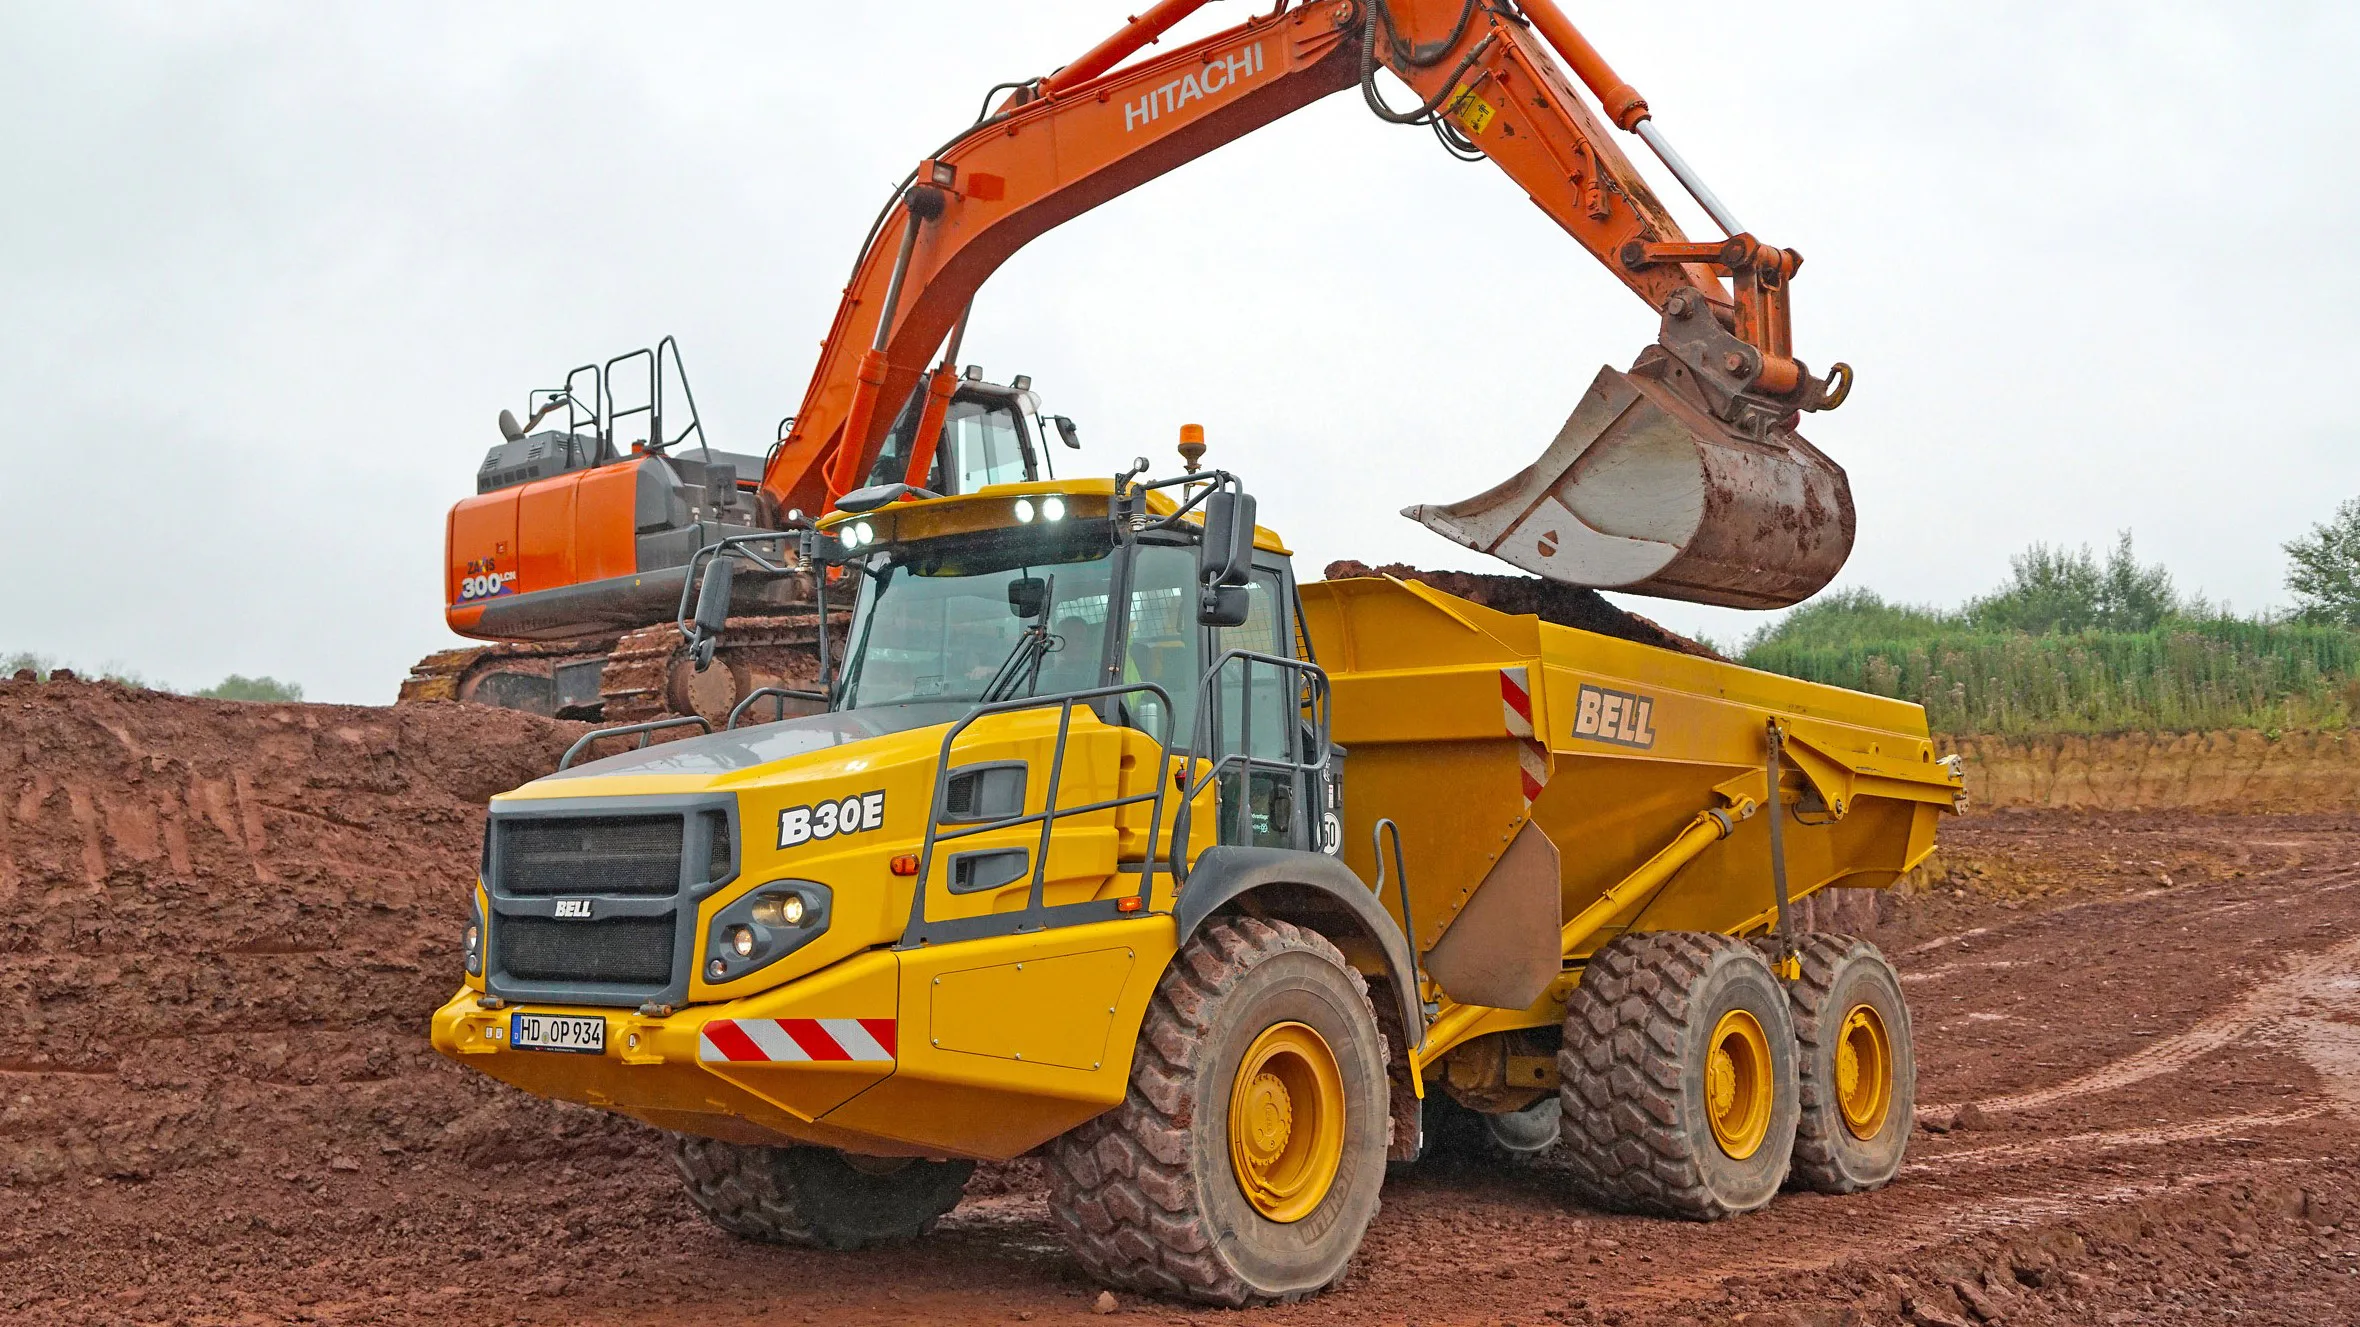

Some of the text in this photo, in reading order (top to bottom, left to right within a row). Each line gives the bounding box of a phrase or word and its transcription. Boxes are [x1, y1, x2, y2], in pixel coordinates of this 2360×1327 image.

[1124, 41, 1264, 133] HITACHI
[461, 572, 501, 599] 300
[1574, 685, 1656, 747] BELL
[778, 791, 885, 848] B30E
[555, 900, 591, 917] BELL
[521, 1018, 540, 1042] HD
[550, 1020, 570, 1043] OP
[573, 1021, 601, 1045] 934
